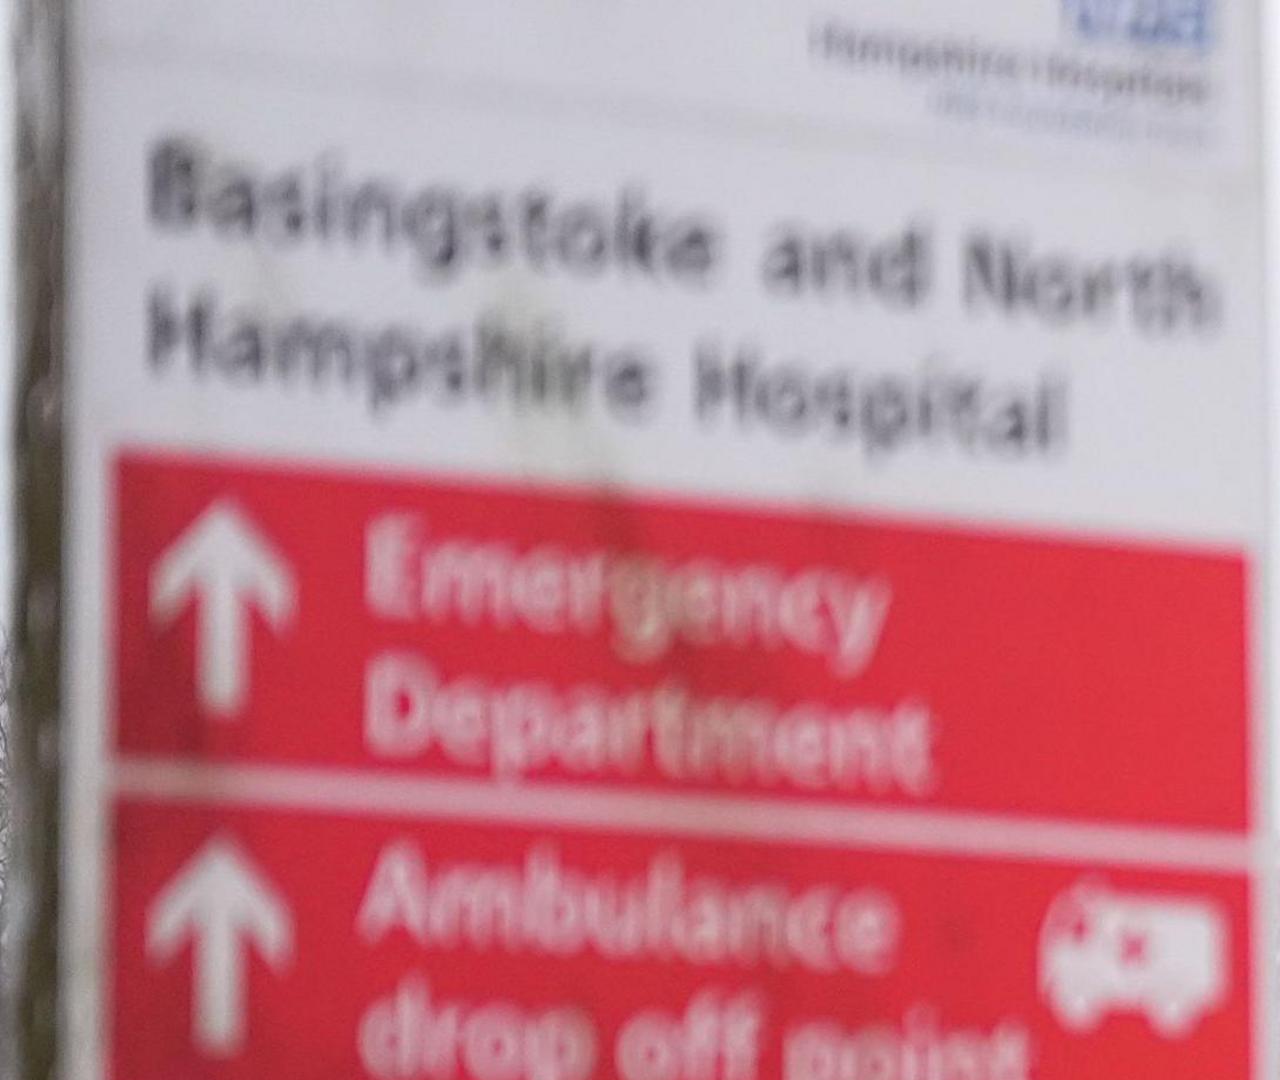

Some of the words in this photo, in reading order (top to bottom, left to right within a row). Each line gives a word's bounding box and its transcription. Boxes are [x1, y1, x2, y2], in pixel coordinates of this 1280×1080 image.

[148, 138, 715, 284] Basingstoke
[762, 212, 931, 308] and
[960, 224, 1224, 336] North
[148, 285, 650, 416] Hampshire
[694, 336, 1067, 464] Hospital
[364, 510, 892, 677] Emergency
[362, 654, 937, 794] Department
[355, 837, 901, 974] Ambulance
